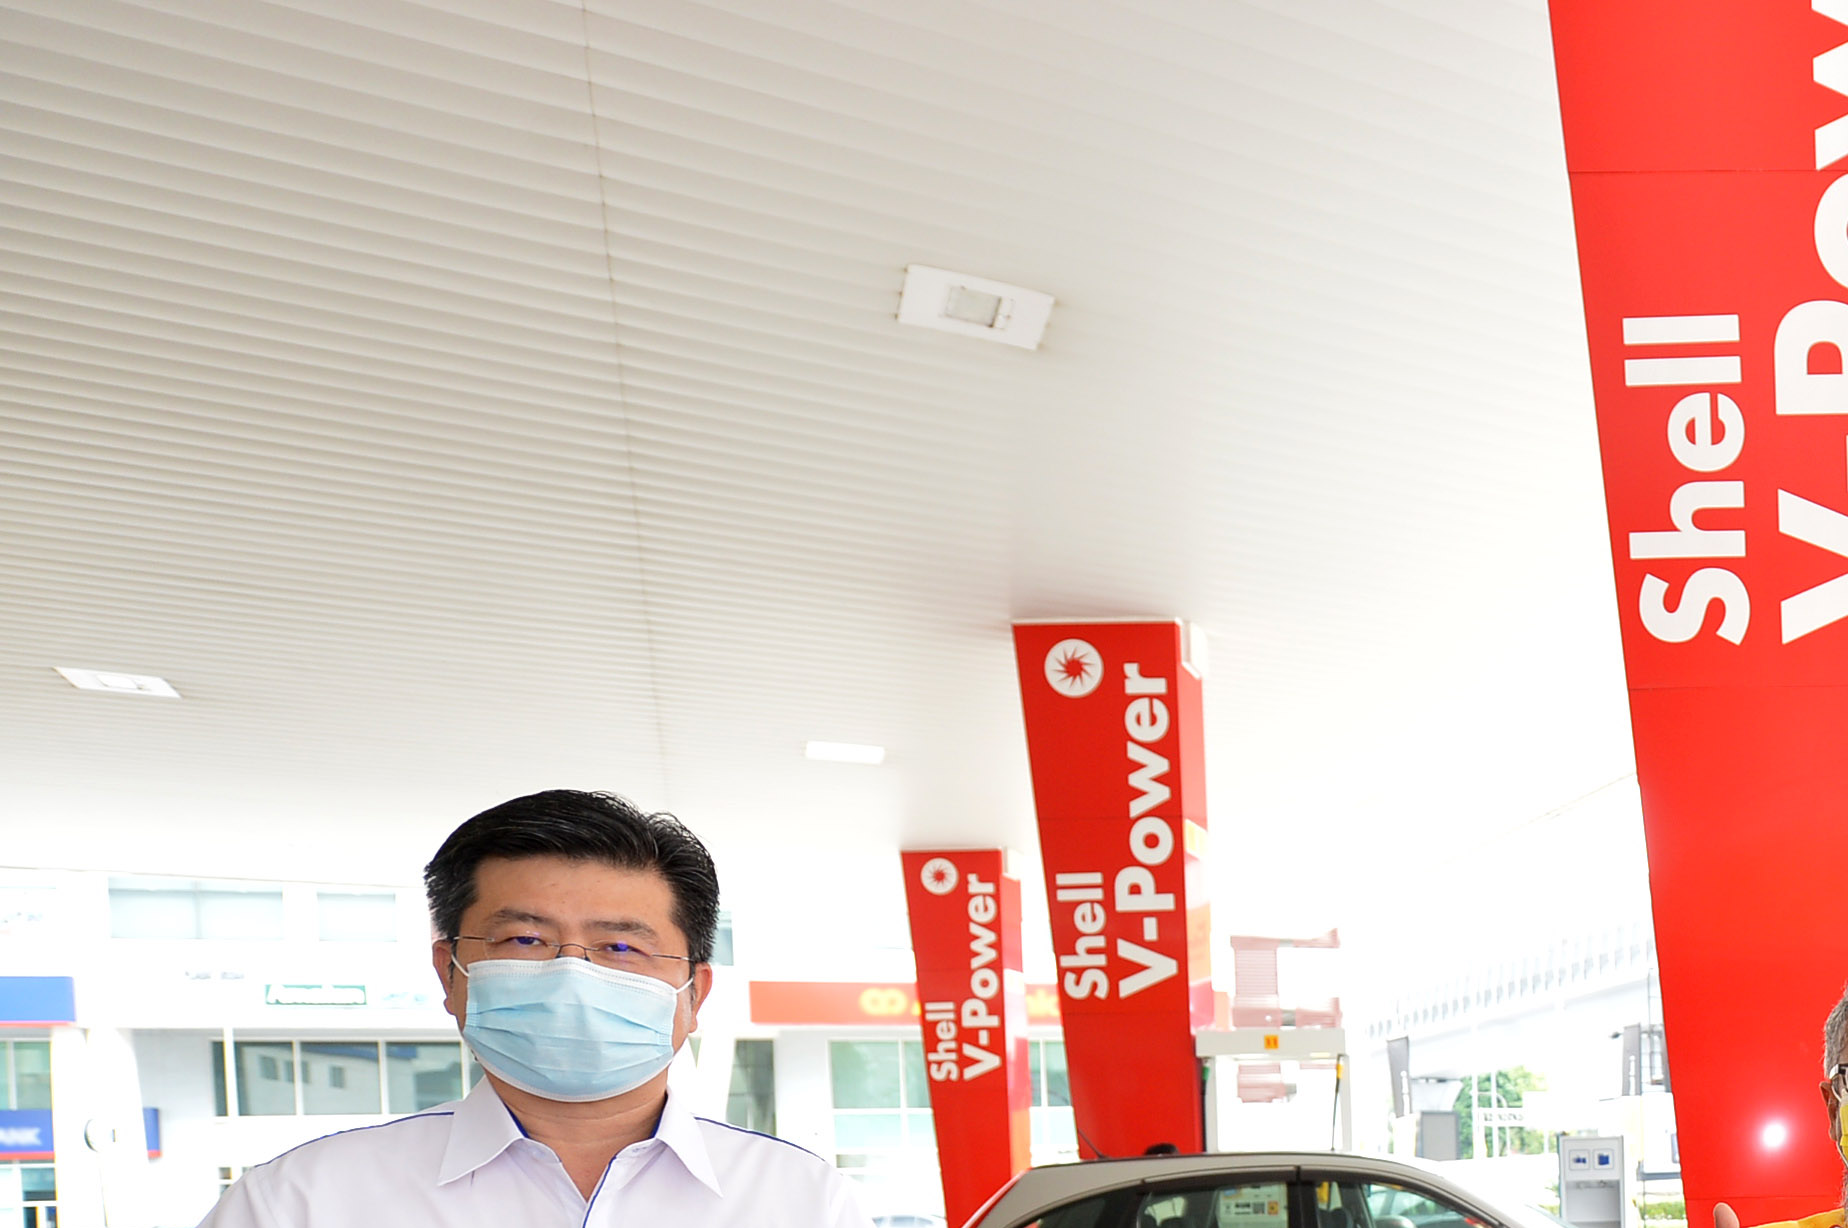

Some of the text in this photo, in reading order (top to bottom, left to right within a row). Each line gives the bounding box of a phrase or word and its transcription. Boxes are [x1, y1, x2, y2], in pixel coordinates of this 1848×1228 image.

[1622, 314, 1750, 646] Shell
[1115, 661, 1179, 999] V-Power
[961, 872, 1001, 1081] V-Power
[1055, 871, 1109, 1001] Shell
[928, 1001, 958, 1082] Shell
